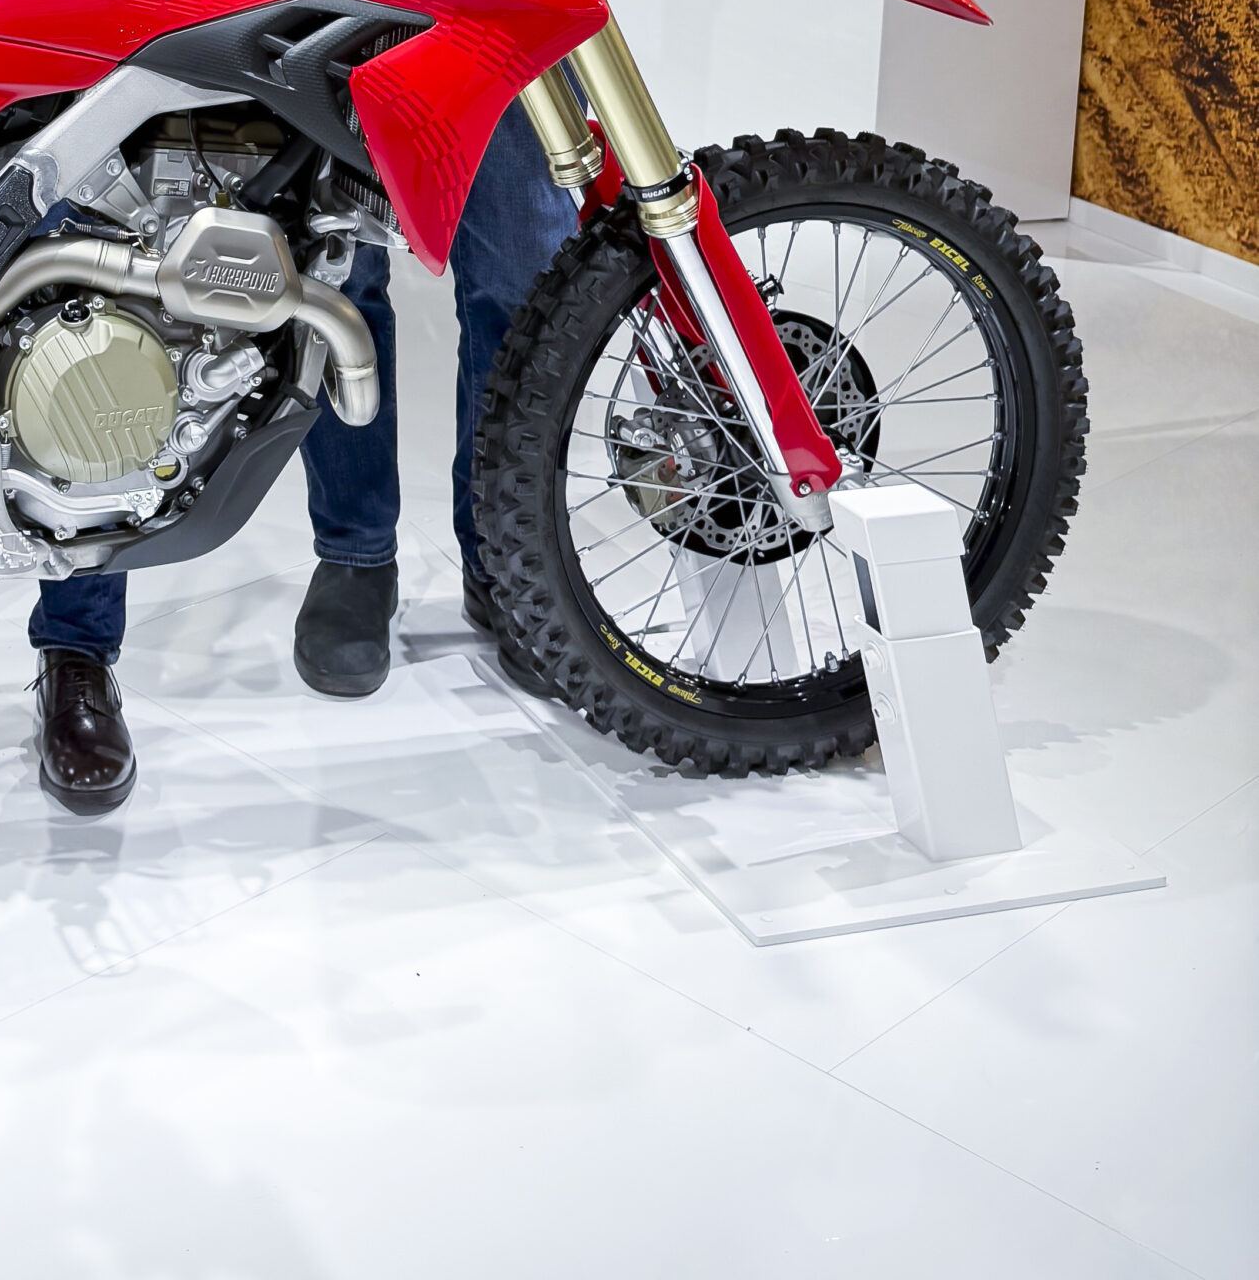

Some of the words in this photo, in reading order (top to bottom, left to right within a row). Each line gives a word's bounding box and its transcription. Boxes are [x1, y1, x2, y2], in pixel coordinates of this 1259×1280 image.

[642, 186, 670, 199] DUCATI
[929, 237, 970, 272] EXCEL
[93, 406, 164, 428] DUCATI
[624, 651, 664, 687] EXCEL
